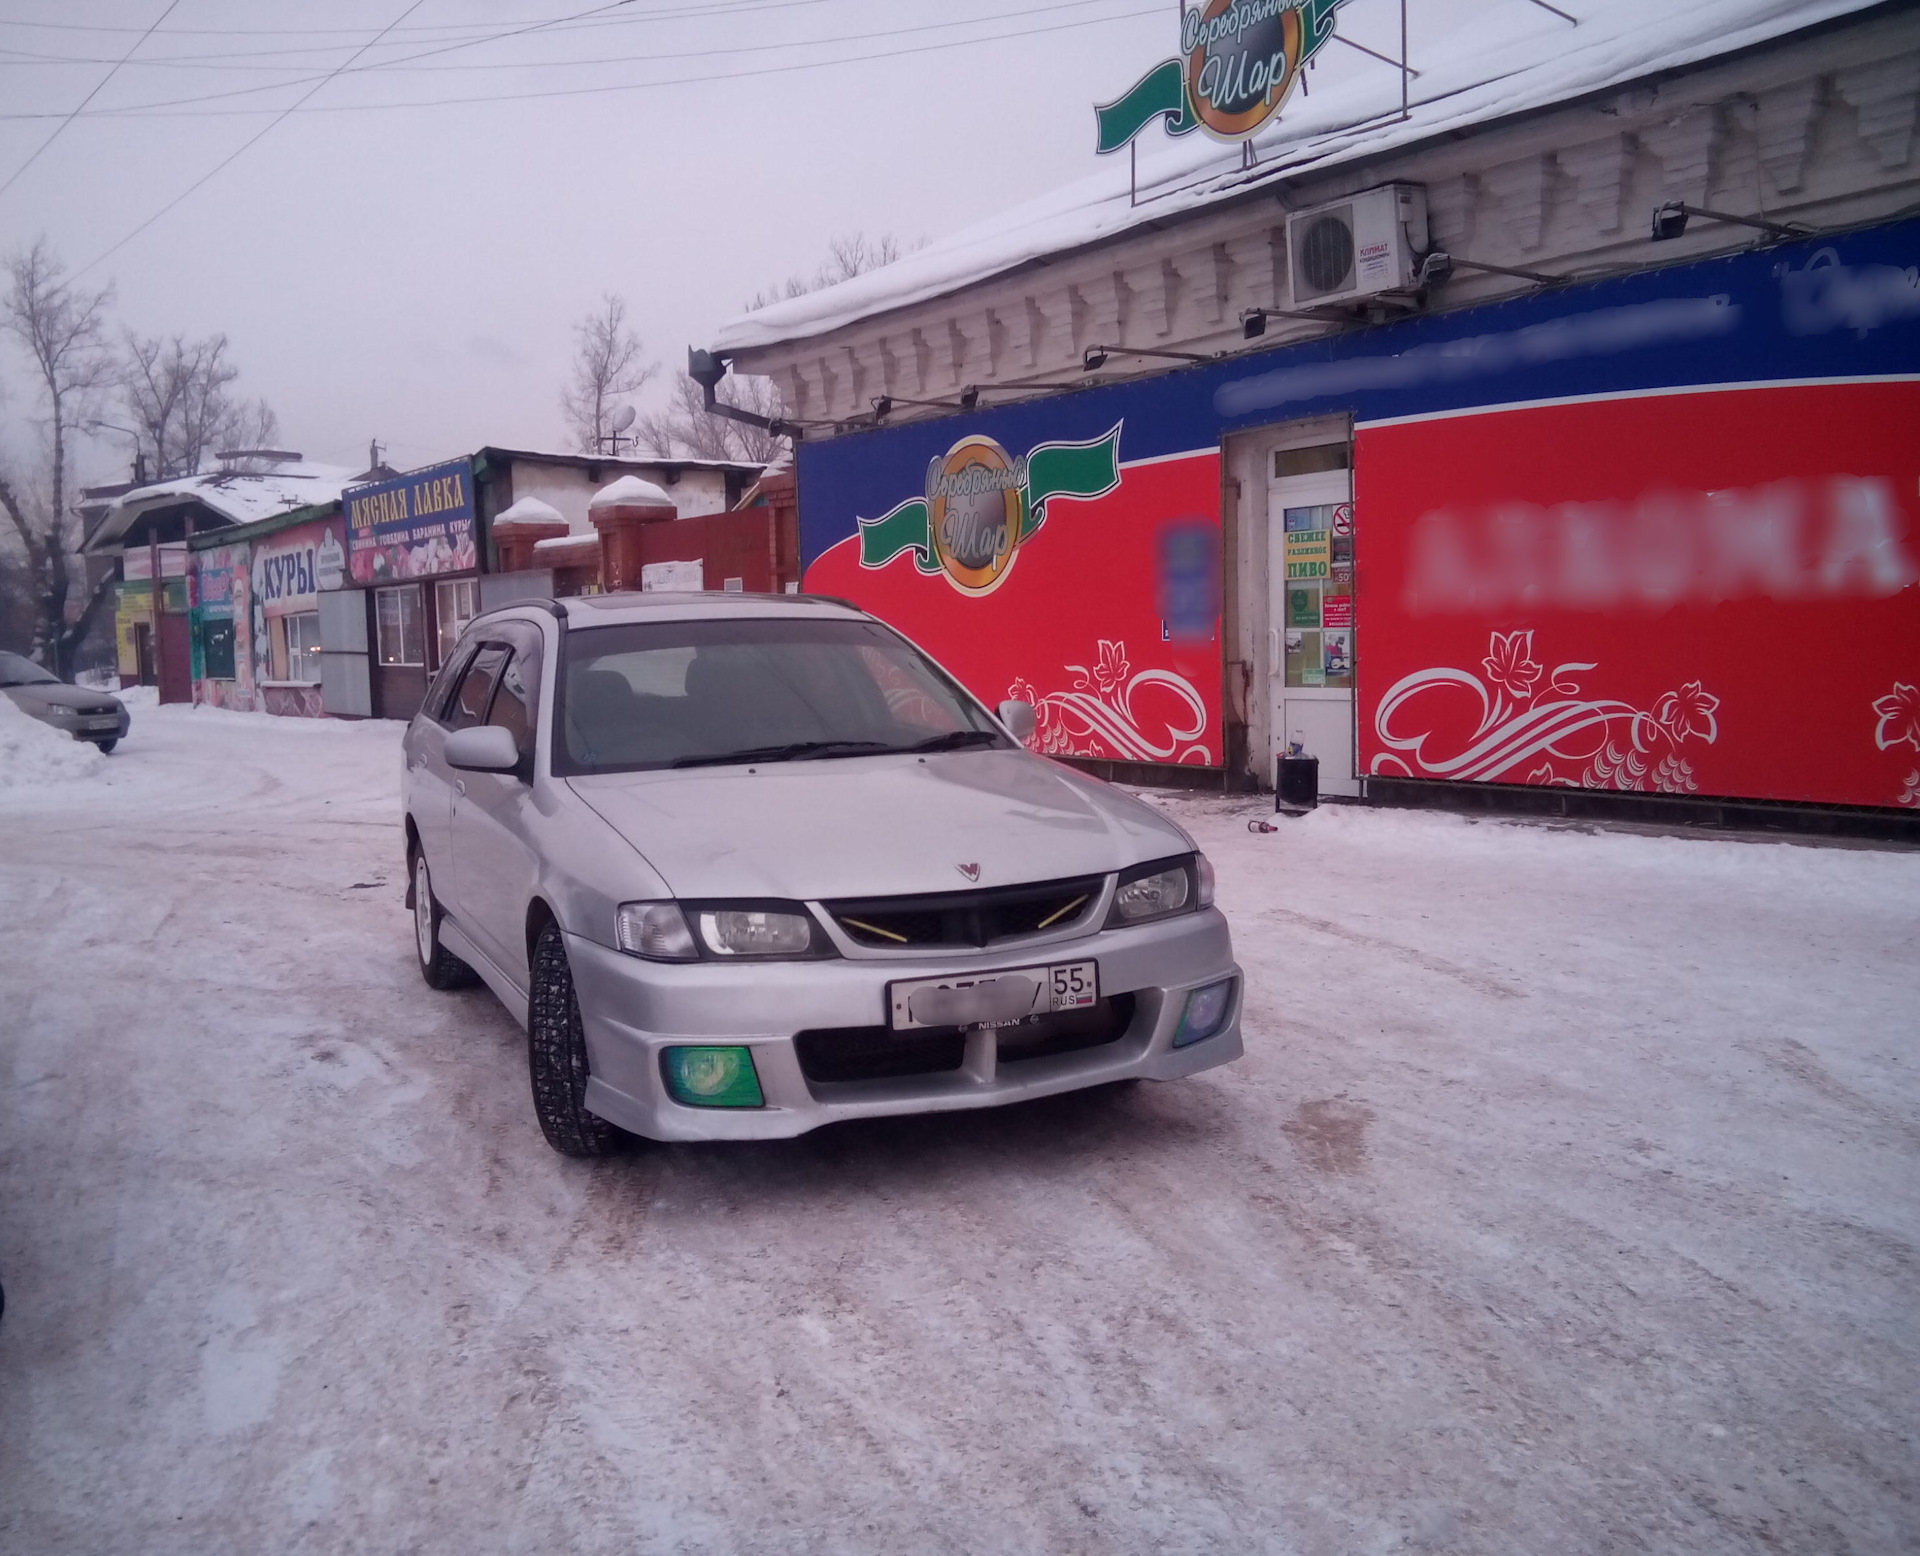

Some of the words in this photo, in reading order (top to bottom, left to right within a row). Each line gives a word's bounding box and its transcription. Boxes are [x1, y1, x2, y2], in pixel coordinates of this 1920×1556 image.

[1198, 50, 1287, 107] Шар
[351, 488, 409, 530] МЯСНАЯ
[414, 474, 465, 516] ЛАВКА
[412, 523, 446, 540] БАРАНИНА
[449, 519, 471, 534] КУРЫ
[941, 507, 1009, 571] Шар
[1288, 531, 1326, 543] СВЕЖЕЕ
[264, 549, 316, 600] КУРЫ
[1288, 561, 1327, 578] ПИВО
[1338, 572, 1351, 582] 50
[1054, 967, 1084, 994] 55
[1052, 995, 1075, 1006] RUS
[978, 1018, 1021, 1030] NISSAN
